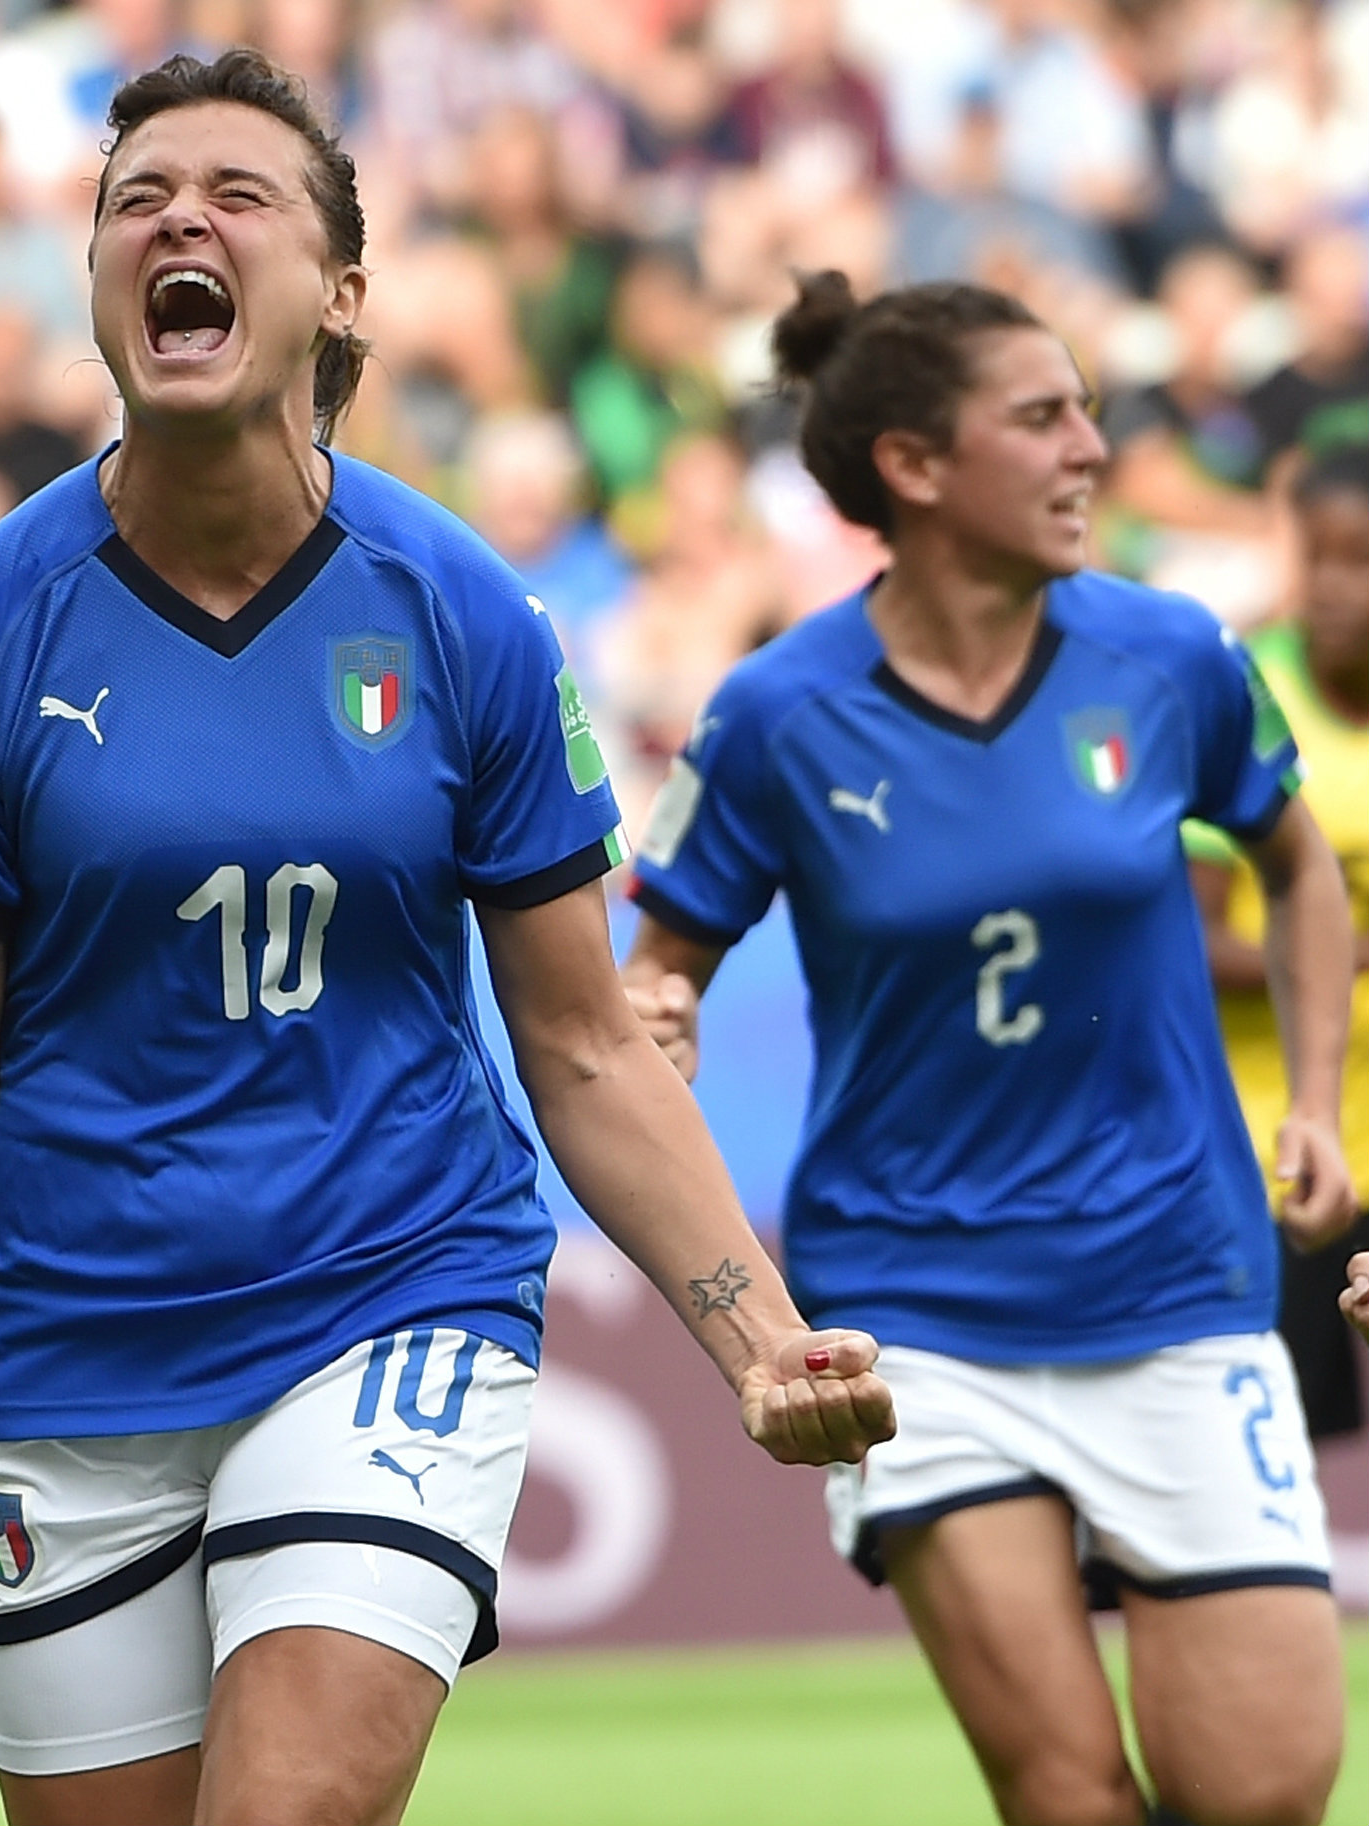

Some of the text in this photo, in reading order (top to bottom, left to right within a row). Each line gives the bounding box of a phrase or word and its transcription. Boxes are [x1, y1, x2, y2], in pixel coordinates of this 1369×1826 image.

[177, 863, 338, 1020] 10
[971, 909, 1045, 1048] 2
[352, 1328, 485, 1439] 10
[1223, 1363, 1296, 1491] 2
